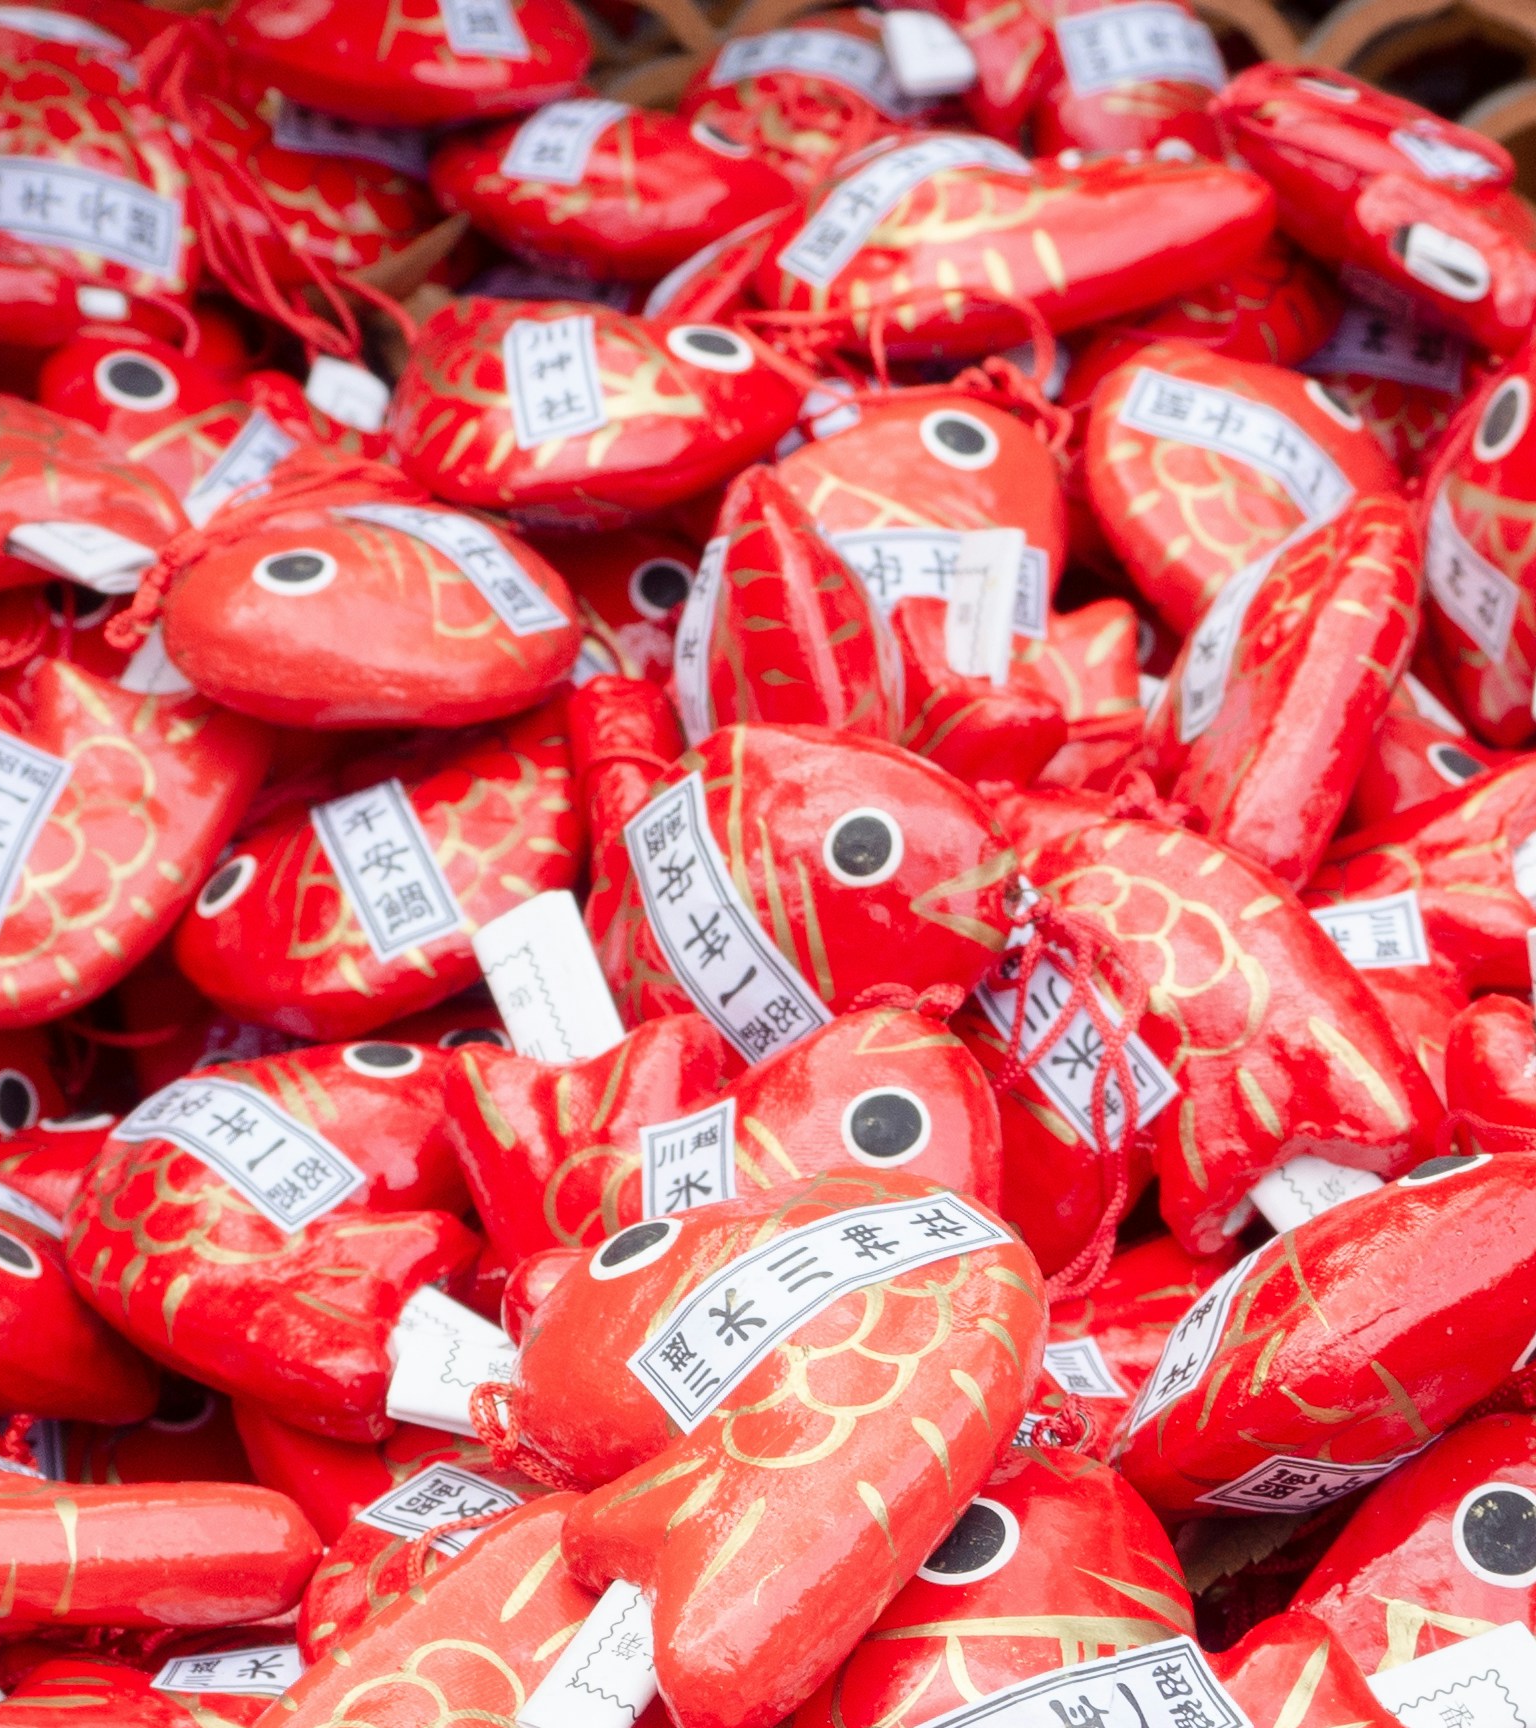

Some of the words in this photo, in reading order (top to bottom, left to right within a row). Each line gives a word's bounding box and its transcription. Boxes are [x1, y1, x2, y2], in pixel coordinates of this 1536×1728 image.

[642, 800, 758, 1006] 一年安鯛
[657, 1124, 722, 1168] 川越
[706, 1206, 970, 1348] 氷川神社
[661, 1331, 724, 1396] 川越
